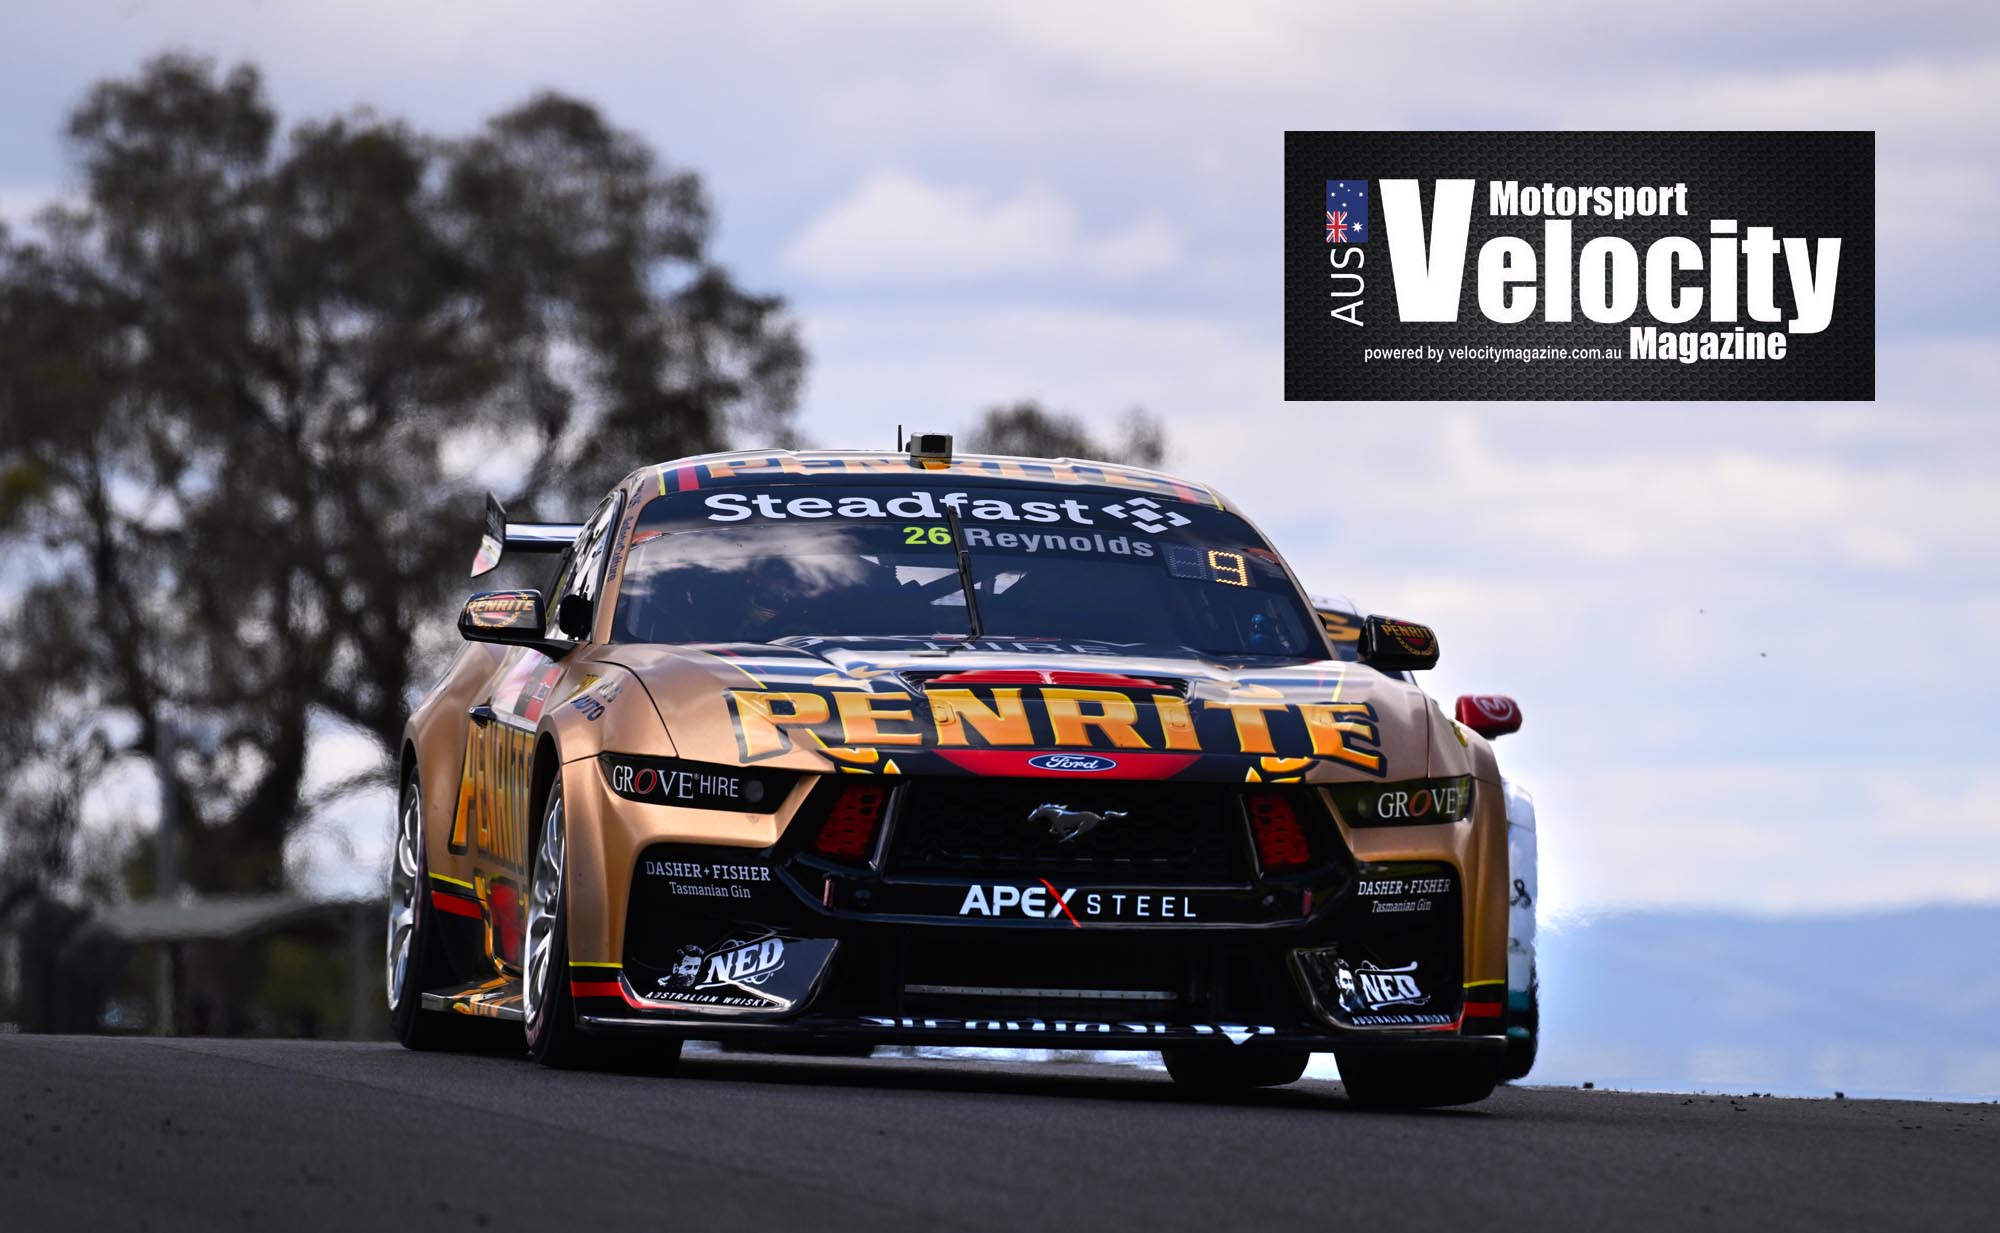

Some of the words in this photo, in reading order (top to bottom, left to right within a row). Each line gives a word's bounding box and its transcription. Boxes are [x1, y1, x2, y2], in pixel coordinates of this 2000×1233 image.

[704, 491, 1094, 525] Steadfast
[903, 527, 951, 545] 26
[963, 528, 1155, 557] Reynolds
[1207, 549, 1248, 588] 9
[466, 600, 535, 615] PENRITE
[728, 687, 1383, 772] PENRITE
[1045, 755, 1099, 770] Ford
[699, 775, 740, 798] HIRE
[646, 861, 702, 878] DASHER
[712, 864, 771, 881] FISHER
[669, 881, 729, 898] Tasmanian
[730, 884, 752, 899] Gin
[1357, 881, 1404, 896] DASHER
[1410, 879, 1451, 894] FISHER
[959, 880, 1080, 926] APEX
[1086, 894, 1197, 917] STEEL
[1372, 900, 1415, 913] Tasmanian
[1416, 898, 1432, 911] Gin
[703, 937, 785, 985] NED
[645, 991, 719, 1004] AUSTRALIAN
[722, 996, 769, 1007] WHISKY
[1360, 974, 1422, 1002] NED
